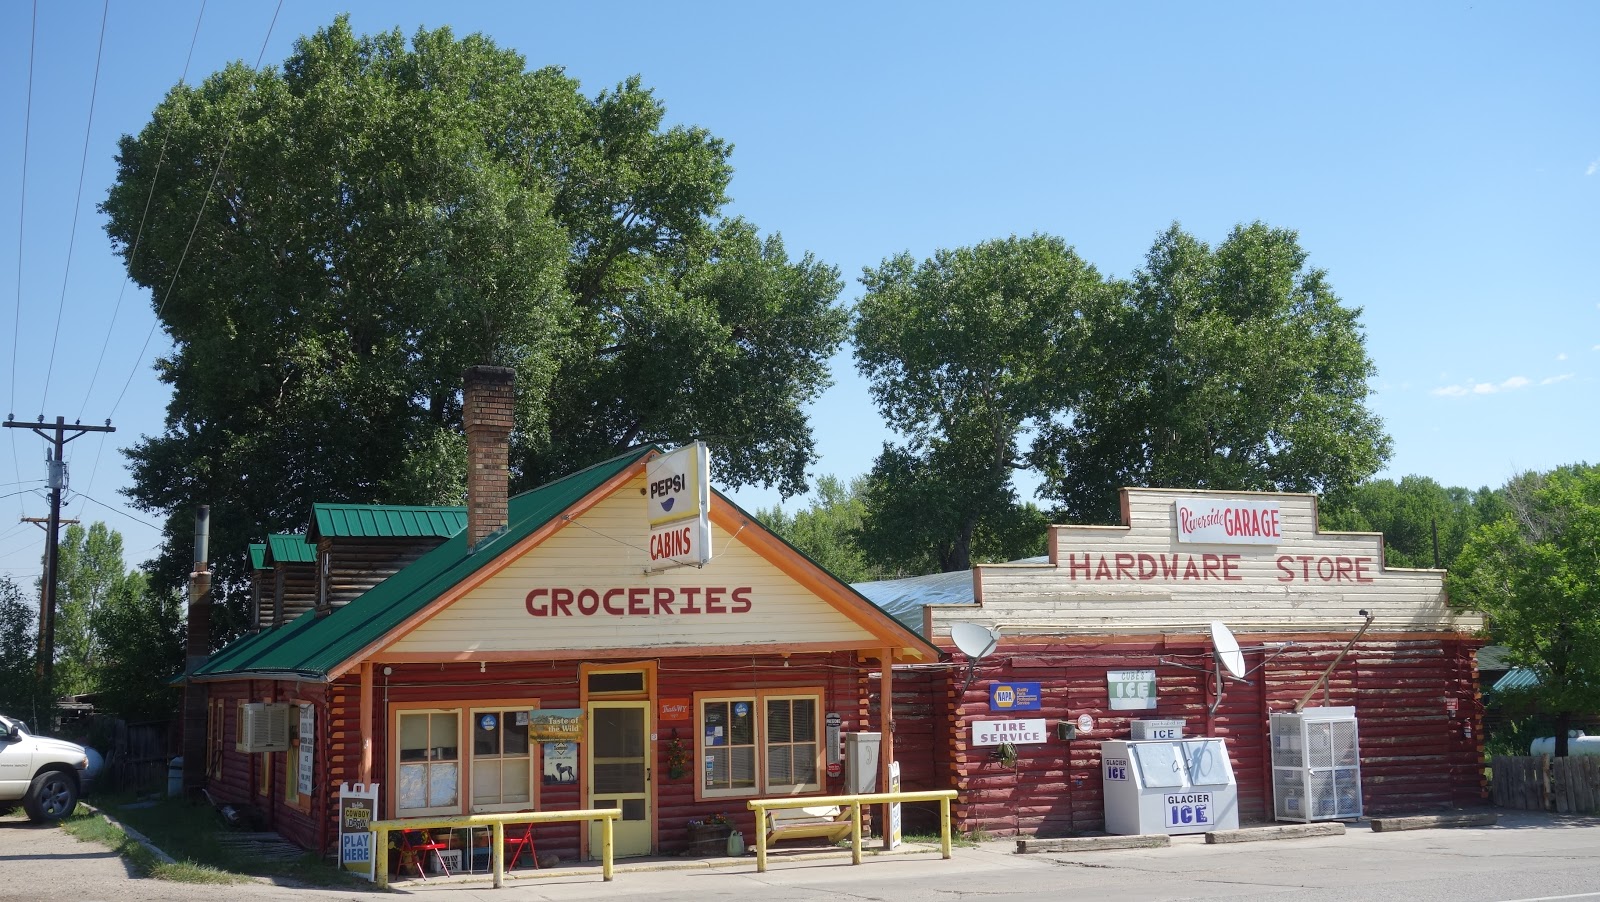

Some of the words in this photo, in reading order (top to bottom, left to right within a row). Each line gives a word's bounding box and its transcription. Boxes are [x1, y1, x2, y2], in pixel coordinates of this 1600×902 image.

[650, 473, 686, 499] PEPSI
[1179, 506, 1224, 534] Riverside
[1224, 507, 1281, 538] GARAGE
[650, 527, 691, 561] CABINS
[1069, 553, 1243, 581] HARDWARE
[1276, 555, 1374, 583] STORE
[525, 586, 752, 617] GROCERIES
[1121, 671, 1146, 681] CUBES
[997, 691, 1013, 702] NAPA
[1116, 682, 1149, 699] ICE
[548, 724, 560, 732] the
[562, 724, 579, 732] Wild
[993, 722, 1026, 732] TIRE
[980, 732, 1040, 743] SERVICE
[1153, 729, 1175, 739] ICE
[1107, 766, 1126, 779] ICE
[1168, 794, 1210, 804] GLACIER
[345, 809, 370, 818] COWBOY
[1171, 804, 1208, 825] ICE
[344, 834, 369, 847] PLAY
[344, 848, 369, 861] HERE
